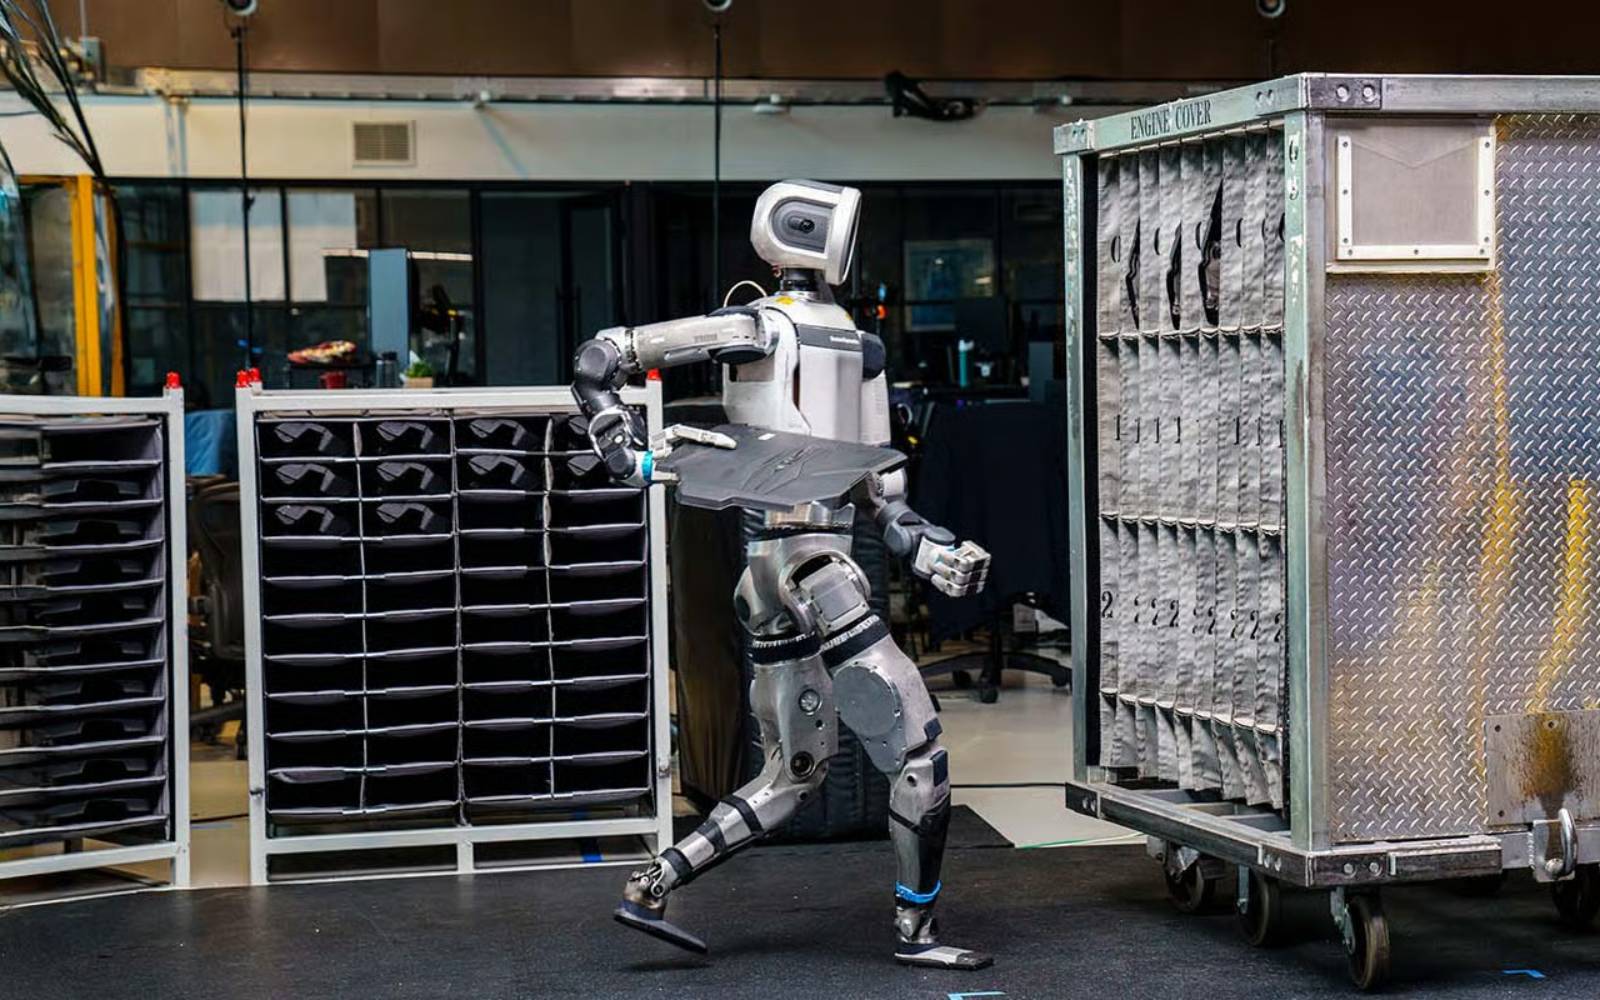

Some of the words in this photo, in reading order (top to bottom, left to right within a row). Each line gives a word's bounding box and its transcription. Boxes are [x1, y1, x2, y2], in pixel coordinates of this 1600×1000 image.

[1130, 109, 1170, 140] ENGINE
[1175, 99, 1211, 130] COVER
[1101, 590, 1114, 619] 2
